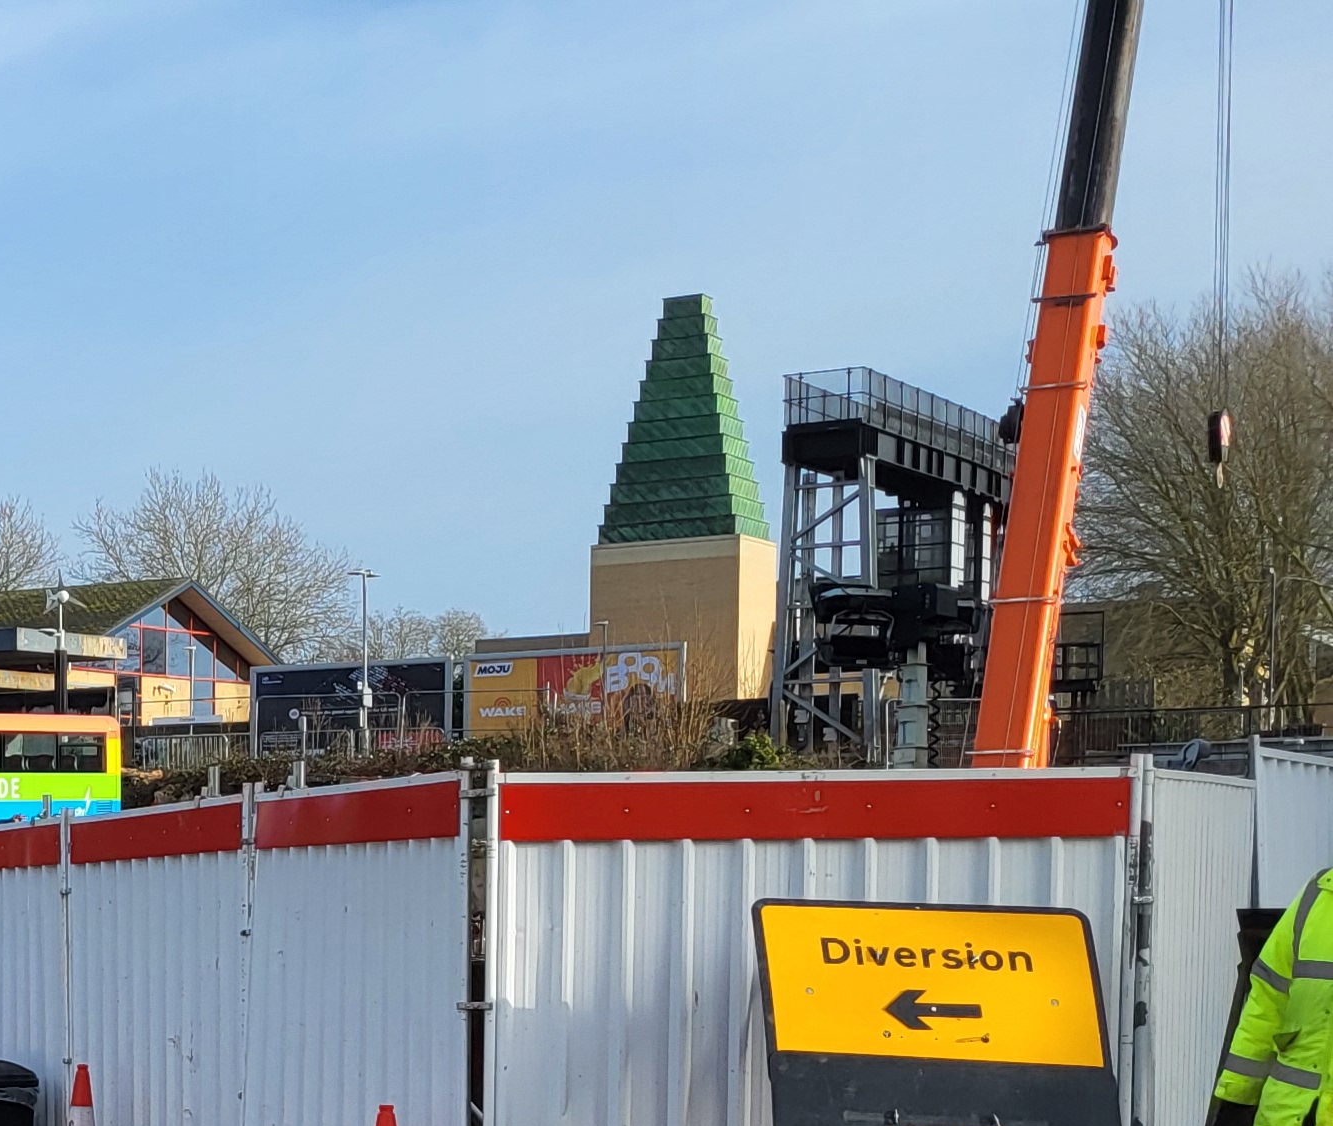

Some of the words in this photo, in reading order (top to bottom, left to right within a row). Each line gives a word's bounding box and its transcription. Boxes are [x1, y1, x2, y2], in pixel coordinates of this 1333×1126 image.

[477, 664, 511, 675] MOJU
[479, 706, 527, 718] WAKE
[819, 936, 1035, 974] Diversion
